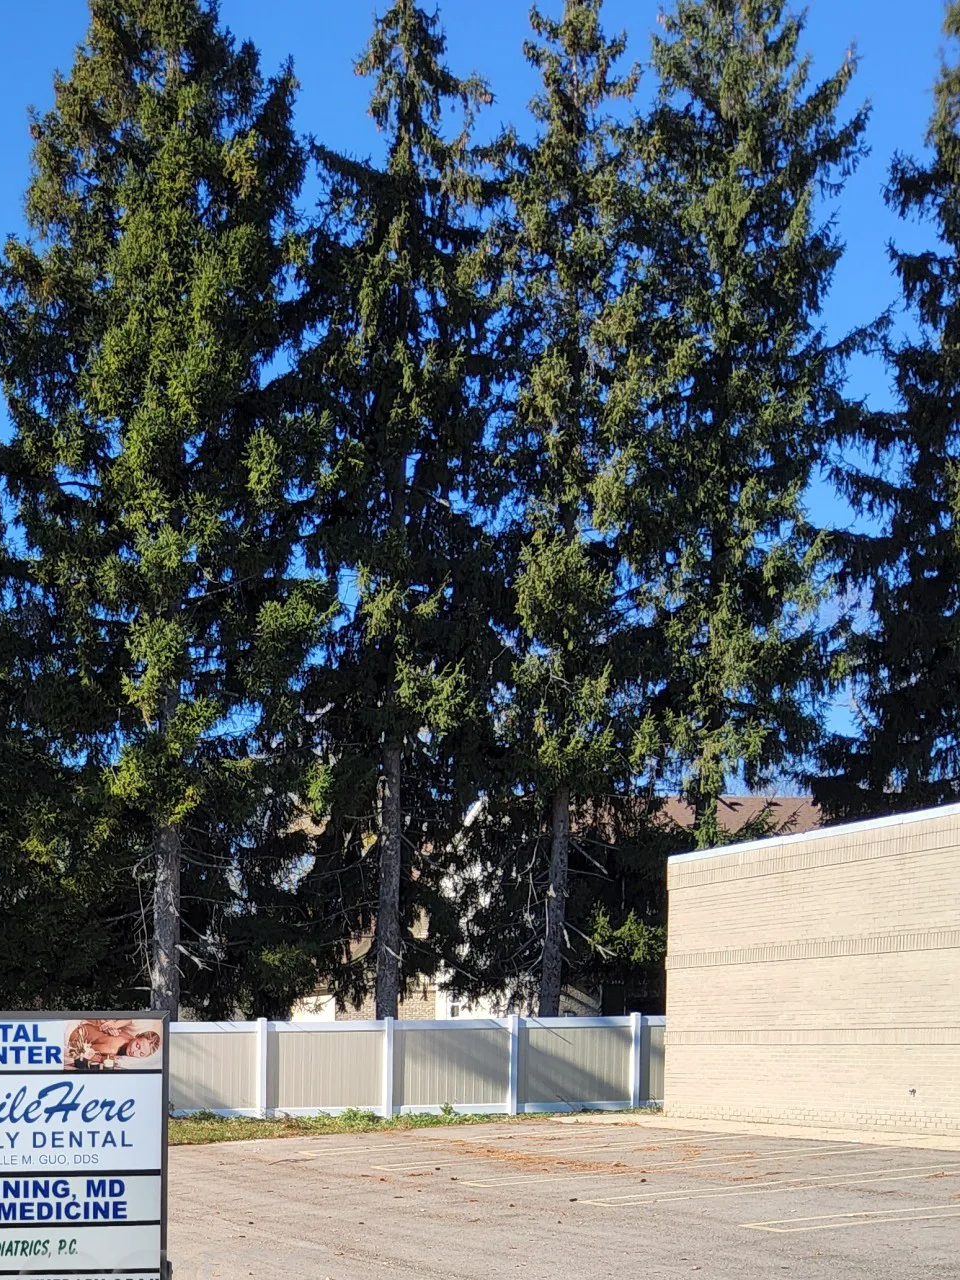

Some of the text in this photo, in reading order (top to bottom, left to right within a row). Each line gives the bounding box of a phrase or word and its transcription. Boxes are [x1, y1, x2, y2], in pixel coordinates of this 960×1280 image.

[32, 1130, 135, 1149] DENTAL
[22, 1155, 36, 1166] M.
[38, 1154, 71, 1167] GUO,
[73, 1153, 100, 1165] DDS
[86, 1179, 127, 1199] MD
[57, 1238, 80, 1256] P.C.
